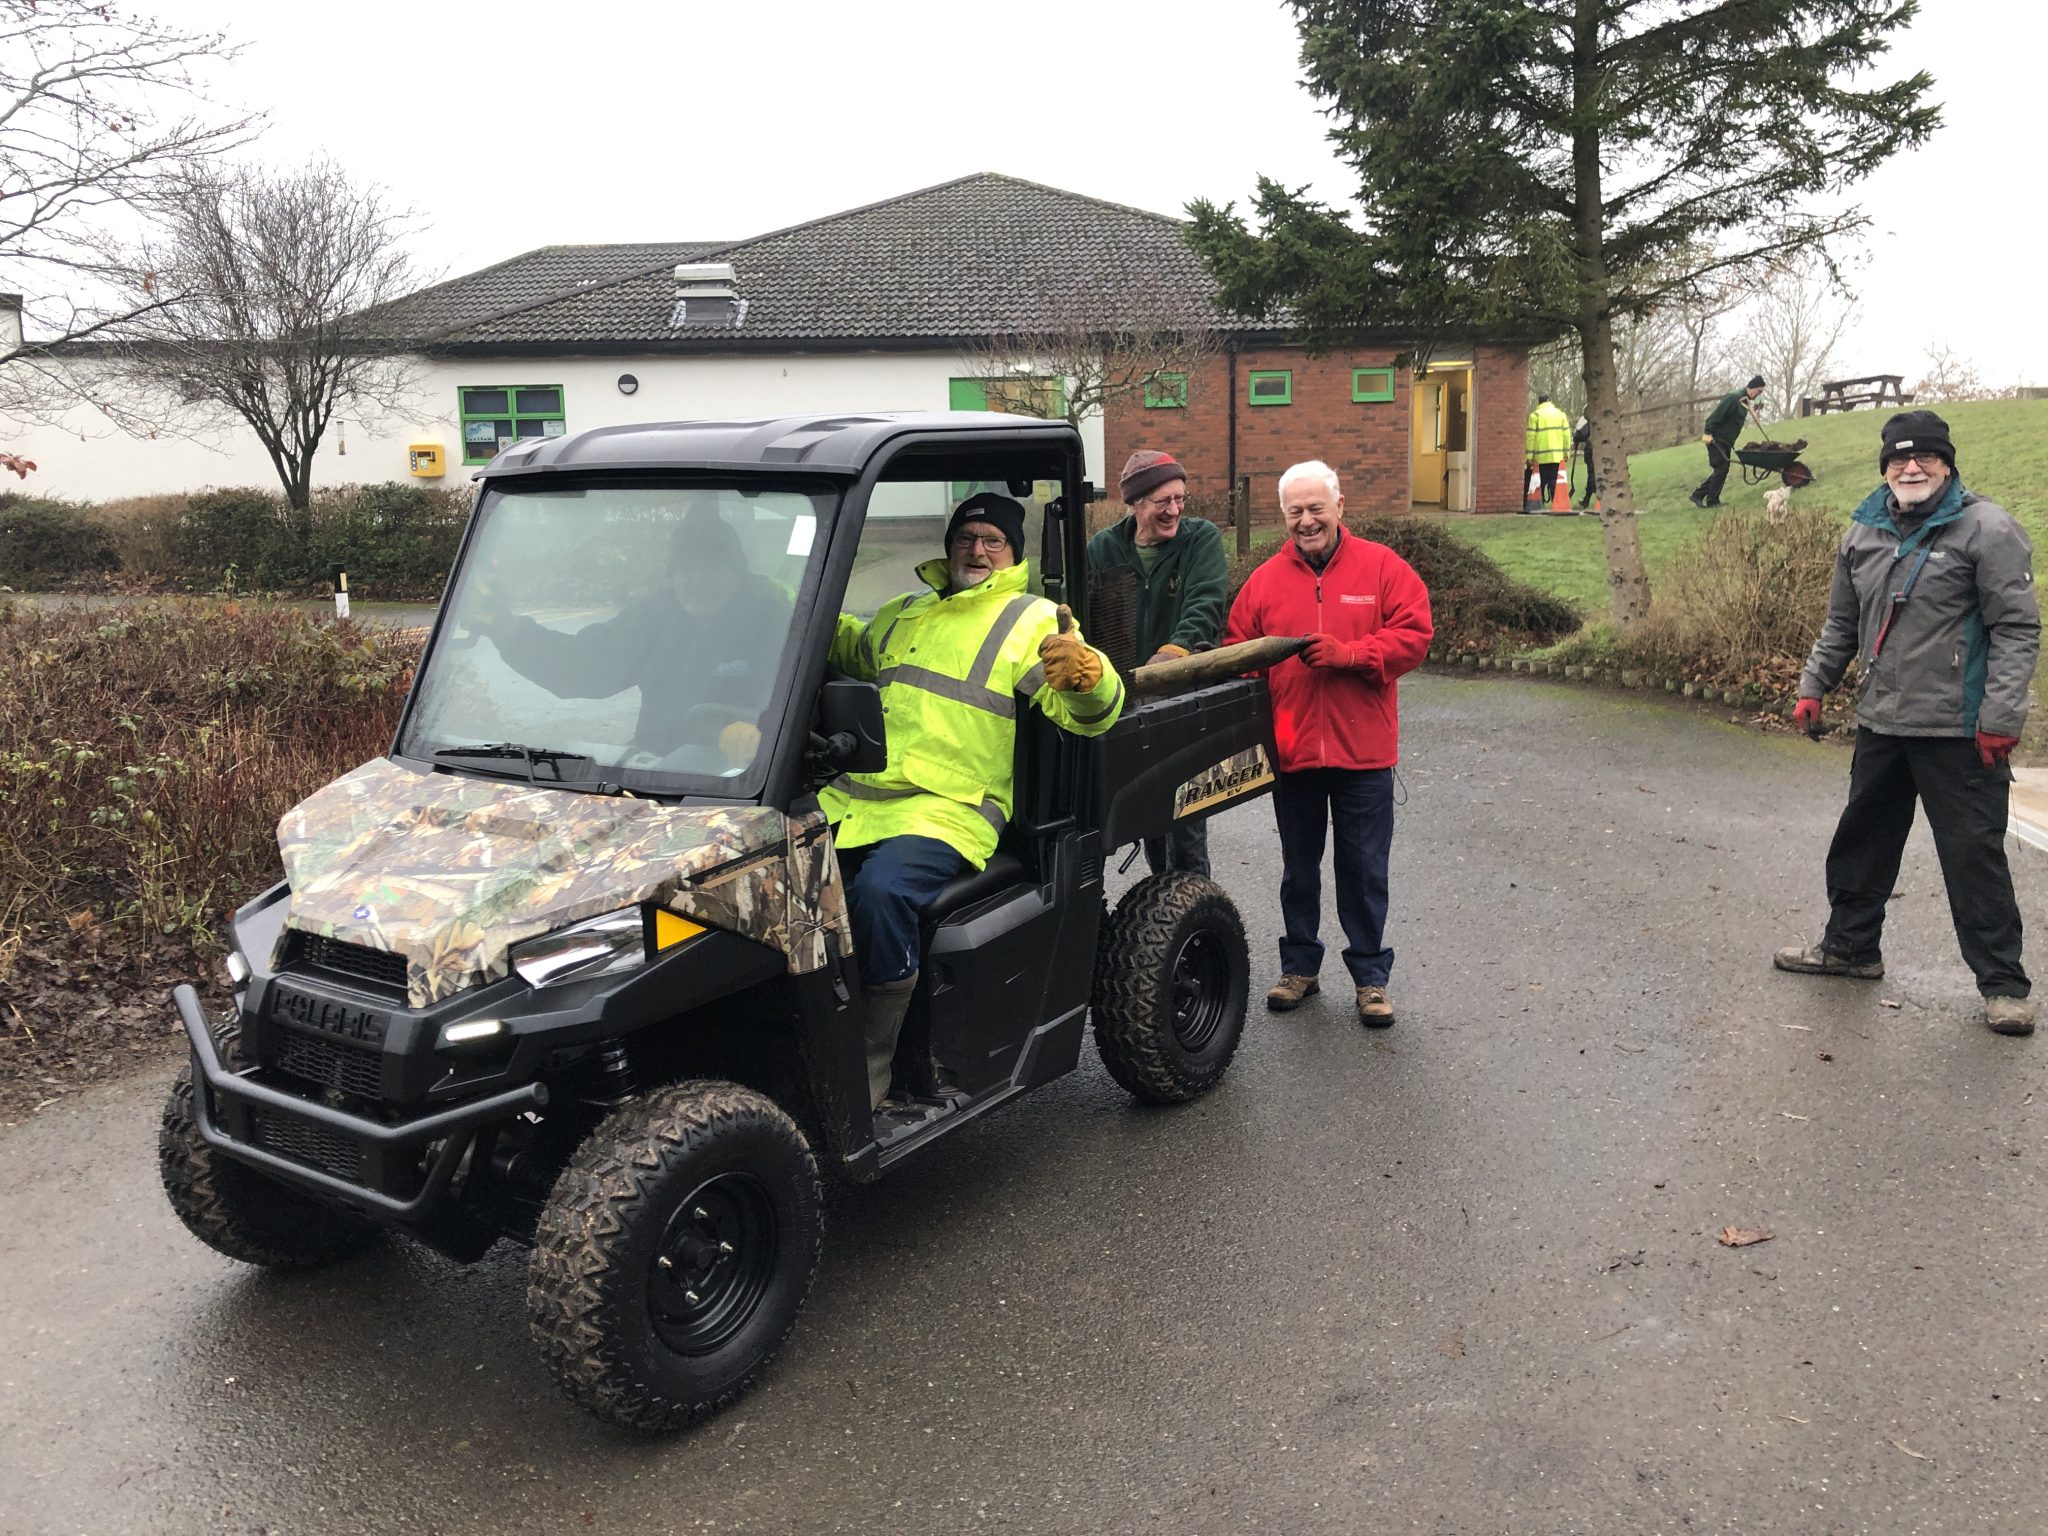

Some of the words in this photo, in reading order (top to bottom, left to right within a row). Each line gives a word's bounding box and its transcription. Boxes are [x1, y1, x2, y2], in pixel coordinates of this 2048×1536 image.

[1185, 762, 1264, 806] RANGER
[1226, 786, 1243, 797] EV
[272, 988, 384, 1044] POLARIS
